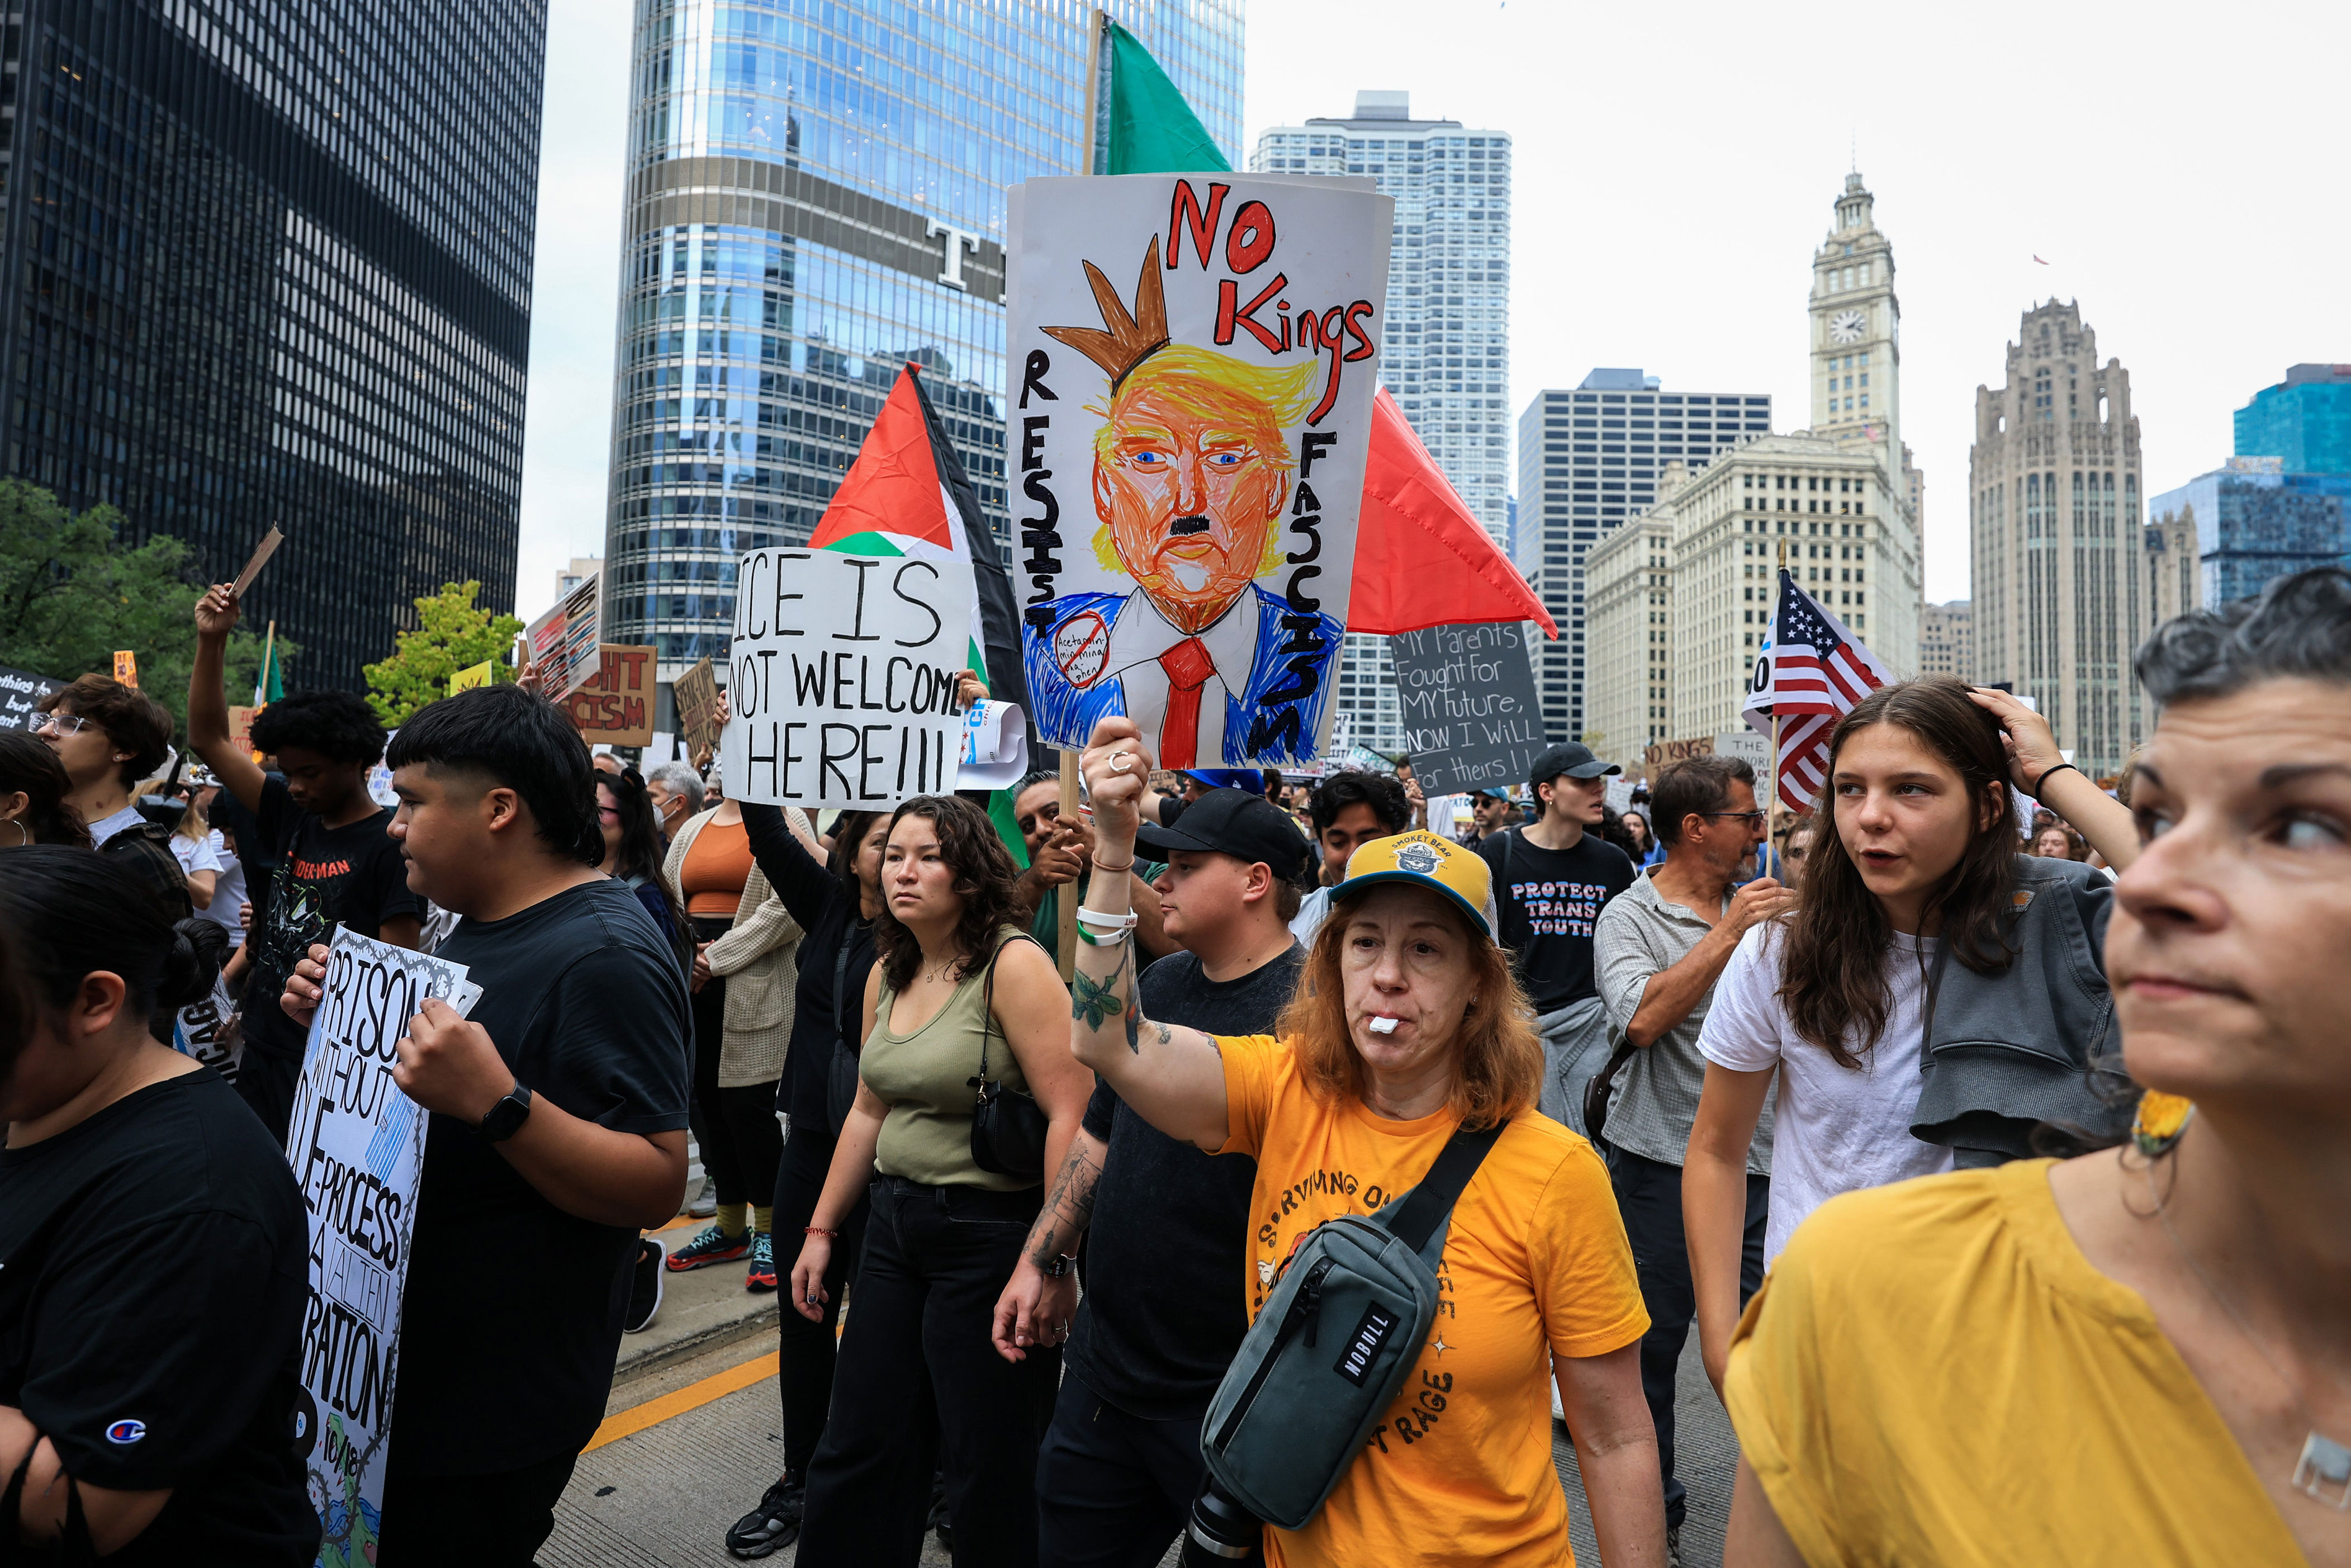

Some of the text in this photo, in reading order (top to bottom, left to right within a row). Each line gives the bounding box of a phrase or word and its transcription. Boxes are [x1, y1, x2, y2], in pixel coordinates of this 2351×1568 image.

[1166, 179, 1276, 274] NO
[1213, 272, 1374, 427] Kings
[1018, 349, 1063, 638] RESIST
[566, 579, 596, 619] NO
[734, 552, 942, 647] ICE IS
[1247, 432, 1338, 760] FASCISM
[1434, 622, 1518, 653] Parents
[729, 650, 778, 719] NOT
[1396, 653, 1503, 693] Fought For
[5, 694, 33, 713] but
[1402, 688, 1523, 719] MY Future,
[1406, 726, 1449, 754] NOW
[1457, 722, 1475, 747] I
[1644, 745, 1662, 765] NO
[1732, 740, 1764, 752] THE
[1411, 761, 1443, 789] For
[1391, 835, 1452, 858] SMOKEY BEAR
[1511, 880, 1607, 902] PROTECT
[1524, 899, 1597, 919] TRANS
[1529, 918, 1593, 937] YOUTH
[322, 949, 432, 1063] PRISON
[311, 1037, 394, 1126] WITHOUT
[1258, 1169, 1359, 1248] SRVIVING
[326, 1247, 390, 1332] ALIEN
[302, 1292, 393, 1436] RATION
[1344, 1314, 1389, 1377] NOBULL
[1395, 1370, 1454, 1445] RAGE
